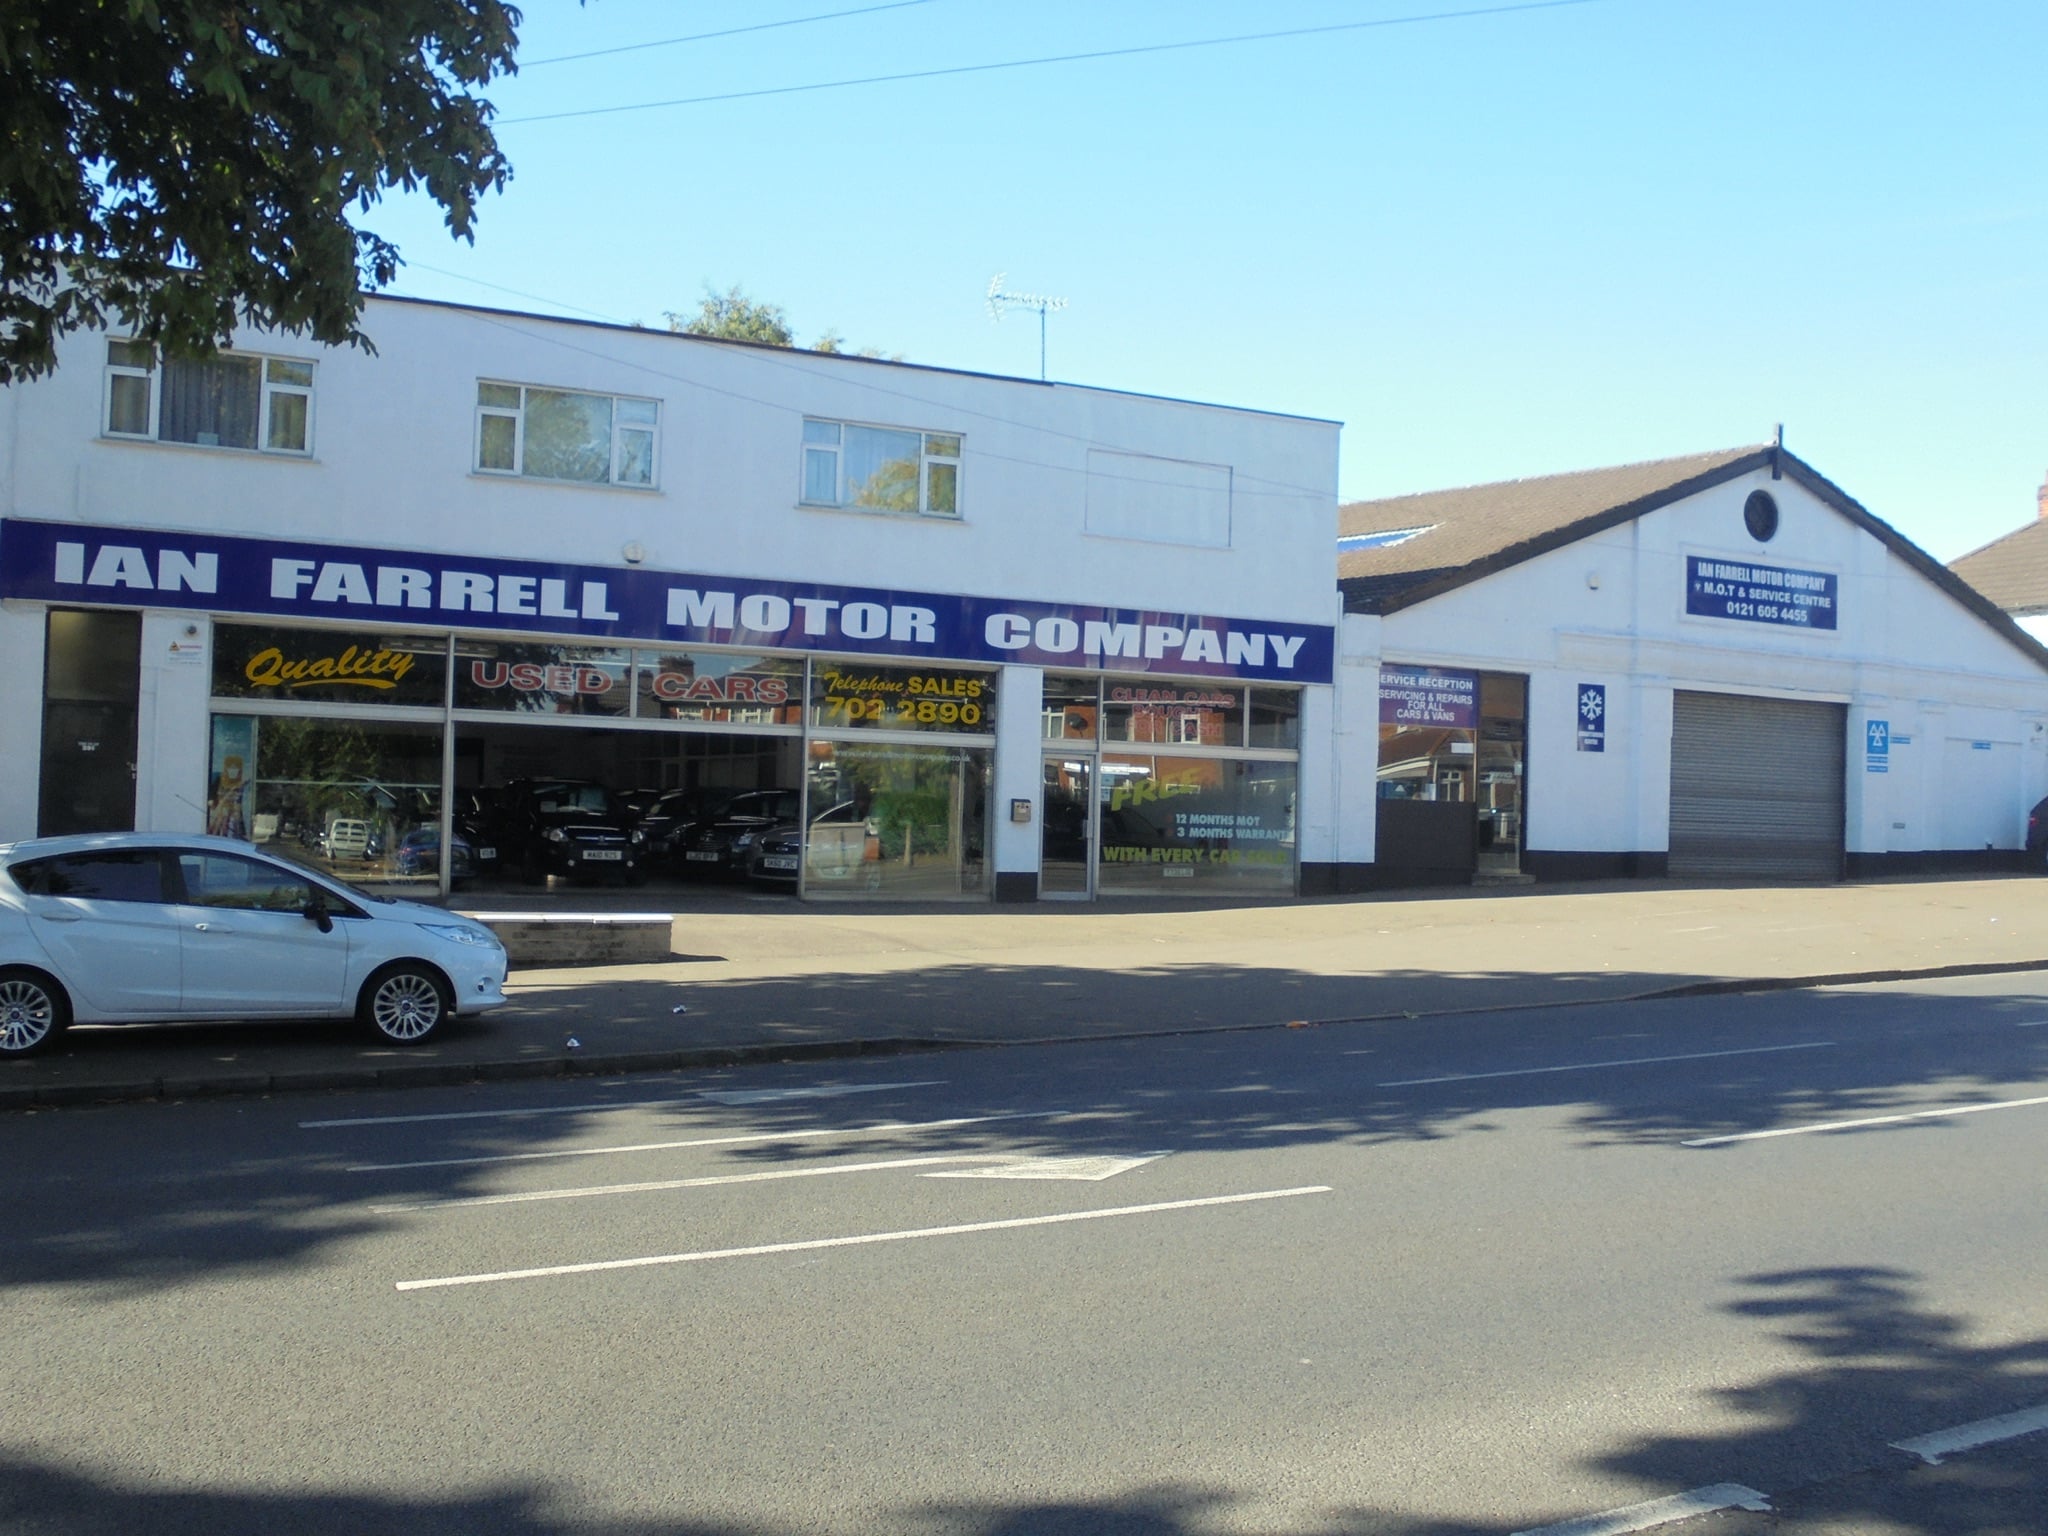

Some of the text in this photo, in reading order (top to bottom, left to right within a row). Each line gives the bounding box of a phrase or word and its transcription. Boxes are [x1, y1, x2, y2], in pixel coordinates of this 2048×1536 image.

[1698, 562, 1826, 592] IAN FARRELL MOTOR COMPANY
[55, 541, 1306, 668] IAN FARRELL MOTOR COMPANY
[1704, 582, 1831, 608] M.O.T & SERVICE CENTRE
[1727, 602, 1808, 622] 0121 605 4455
[245, 645, 414, 688] Quality
[472, 661, 788, 704] USED CARS
[824, 671, 981, 698] Telephone SALES
[1380, 674, 1473, 690] ERVICE RECEPTION
[1111, 687, 1235, 708] CLEAN CARS
[1379, 688, 1473, 705] SERVICING & REPAIRS
[1408, 701, 1444, 712] FOR ALL
[825, 697, 980, 724] 702 2890
[1396, 709, 1455, 721] CARS & VANS
[1111, 767, 1201, 811] FREE
[1175, 813, 1260, 826] 12 MONTHS MOT
[1177, 827, 1290, 840] 3 MONTHS WARRANT
[1104, 846, 1147, 861] WITH
[1152, 847, 1203, 862] EVERY
[1209, 849, 1242, 864] CAR
